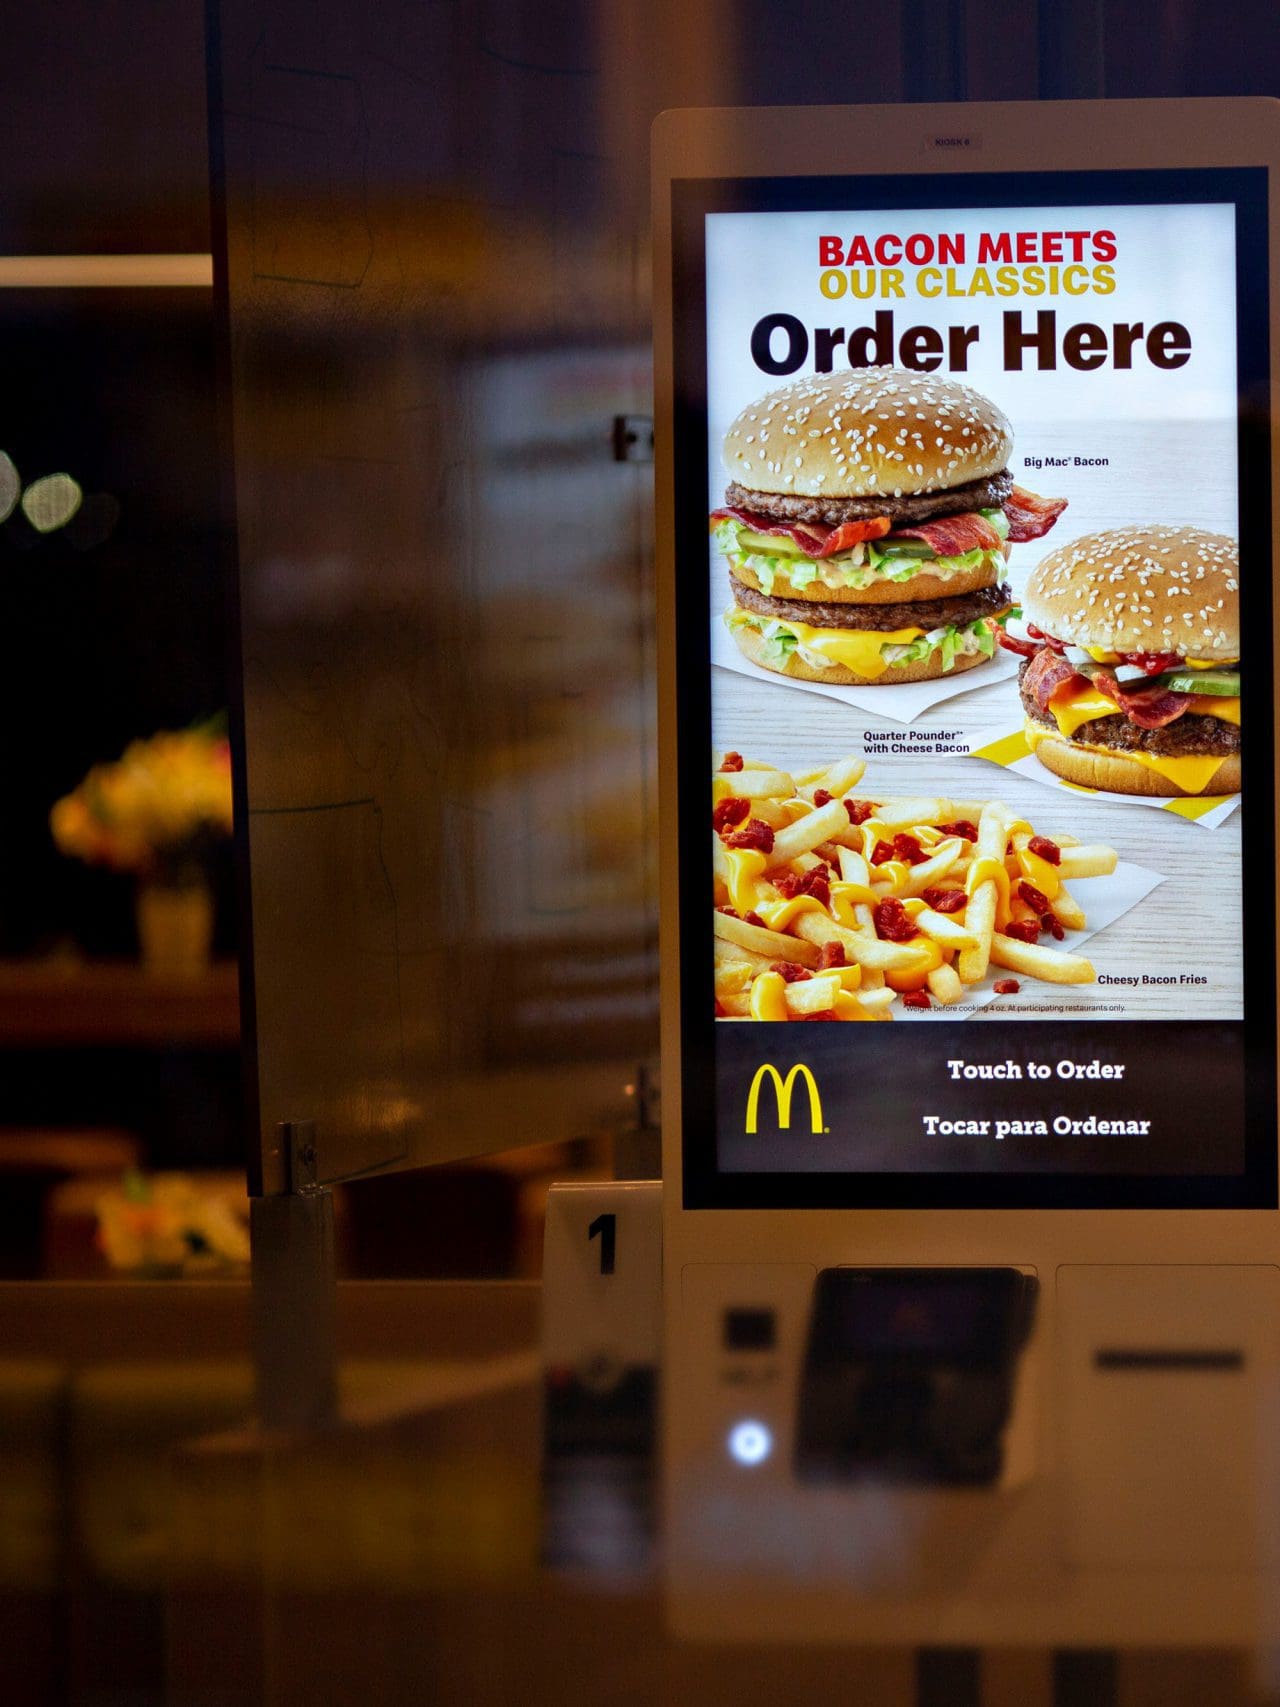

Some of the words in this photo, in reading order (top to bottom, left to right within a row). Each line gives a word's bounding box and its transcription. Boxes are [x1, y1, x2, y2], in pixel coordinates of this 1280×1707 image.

[934, 138, 962, 147] KIOSK
[818, 233, 966, 267] BACON
[977, 230, 1118, 264] MEETS
[819, 268, 906, 300] OUR
[916, 264, 1117, 297] CLASSICS
[750, 309, 980, 376] Order
[1002, 309, 1192, 372] Here
[1024, 456, 1043, 470] Big
[1074, 456, 1109, 466] Bacon
[863, 731, 907, 742] Quarter
[863, 743, 889, 753] with
[891, 743, 933, 753] Cheese
[935, 743, 970, 753] Bacon
[1097, 974, 1140, 987] Cheesy
[1142, 974, 1177, 985] Bacon
[1179, 974, 1208, 985] Fries
[933, 1004, 958, 1012] before
[958, 1004, 988, 1013] cooking
[1008, 1004, 1018, 1012] At
[1018, 1004, 1064, 1013] participating
[1065, 1004, 1108, 1012] restaurants
[1108, 1003, 1126, 1013] only.
[947, 1059, 1023, 1080] Touch
[1028, 1061, 1051, 1080] to
[1056, 1059, 1126, 1080] Order
[923, 1116, 992, 1136] Tocar
[995, 1119, 1050, 1140] para
[1053, 1115, 1152, 1136] Ordenar
[588, 1213, 617, 1276] 1
